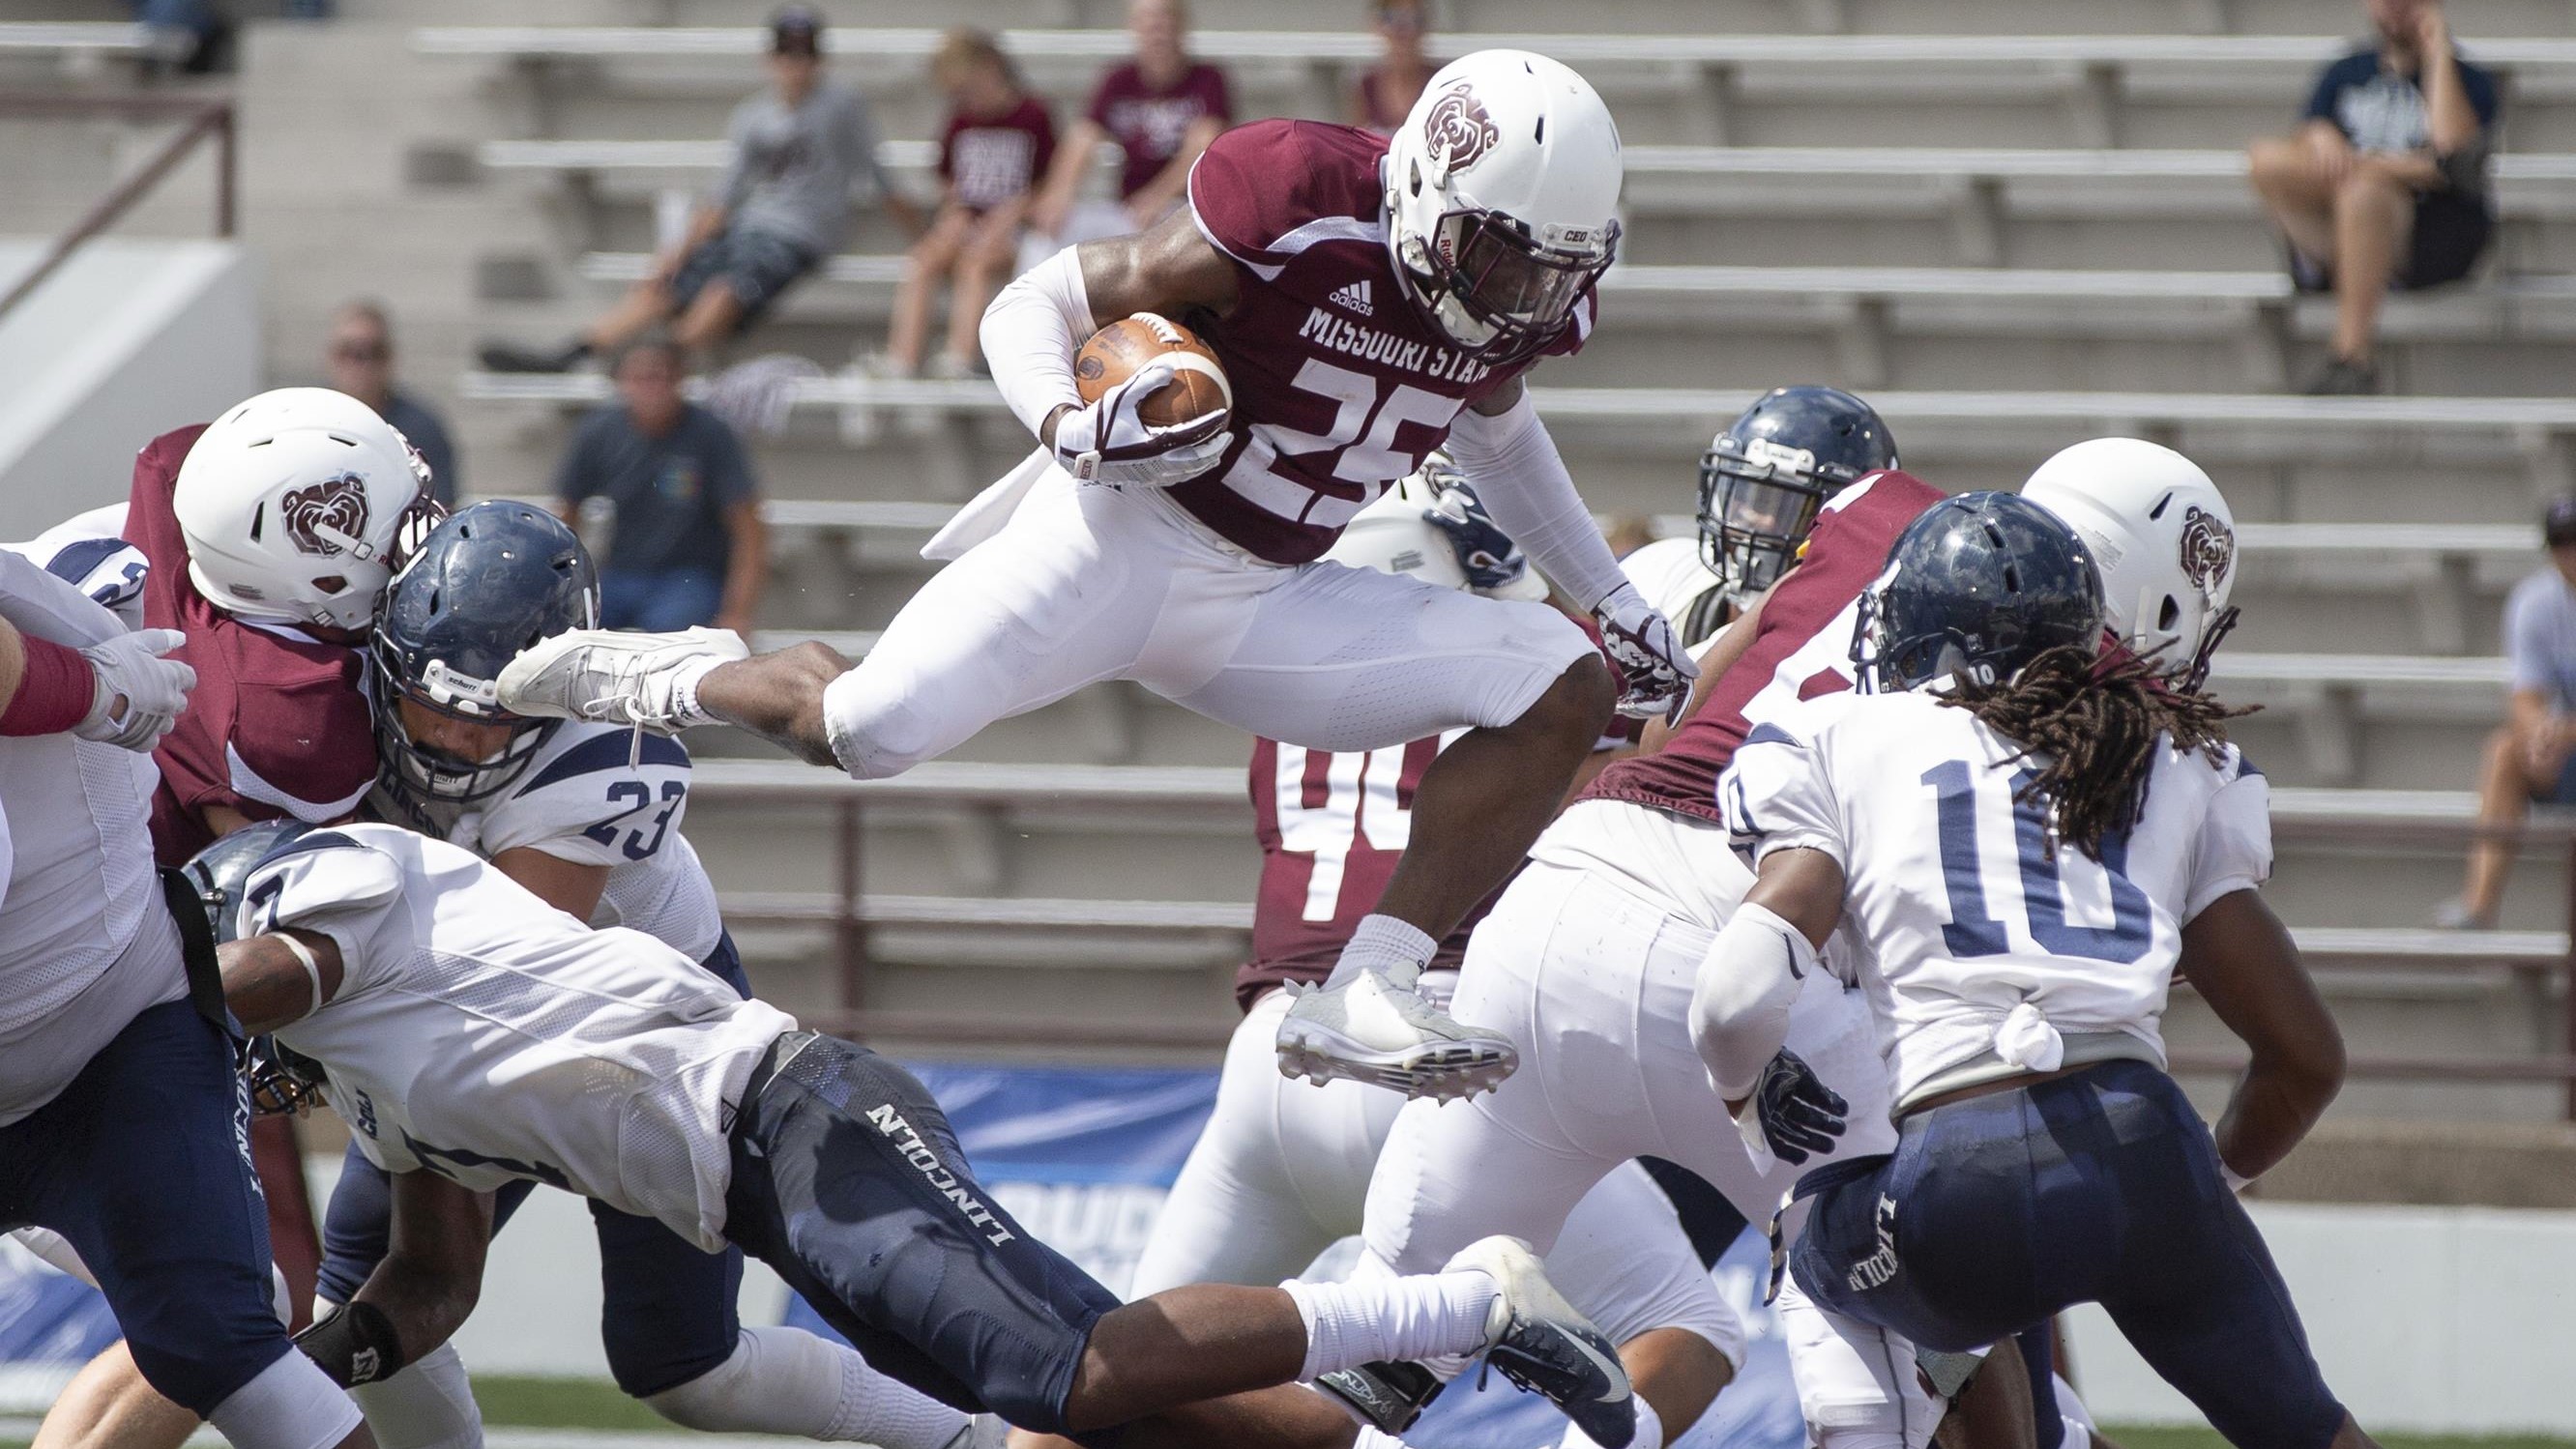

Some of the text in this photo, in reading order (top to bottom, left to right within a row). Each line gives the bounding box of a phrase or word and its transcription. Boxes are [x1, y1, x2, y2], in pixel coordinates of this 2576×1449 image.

[1441, 239, 1455, 265] Ridd
[1564, 229, 1589, 243] CEO
[1299, 306, 1429, 372] MISSOURI
[1329, 291, 1374, 317] adidas
[1220, 357, 1467, 529] 25
[579, 780, 687, 861] 23
[1920, 759, 2153, 965] 10
[865, 1103, 1016, 1247] LINCOLN
